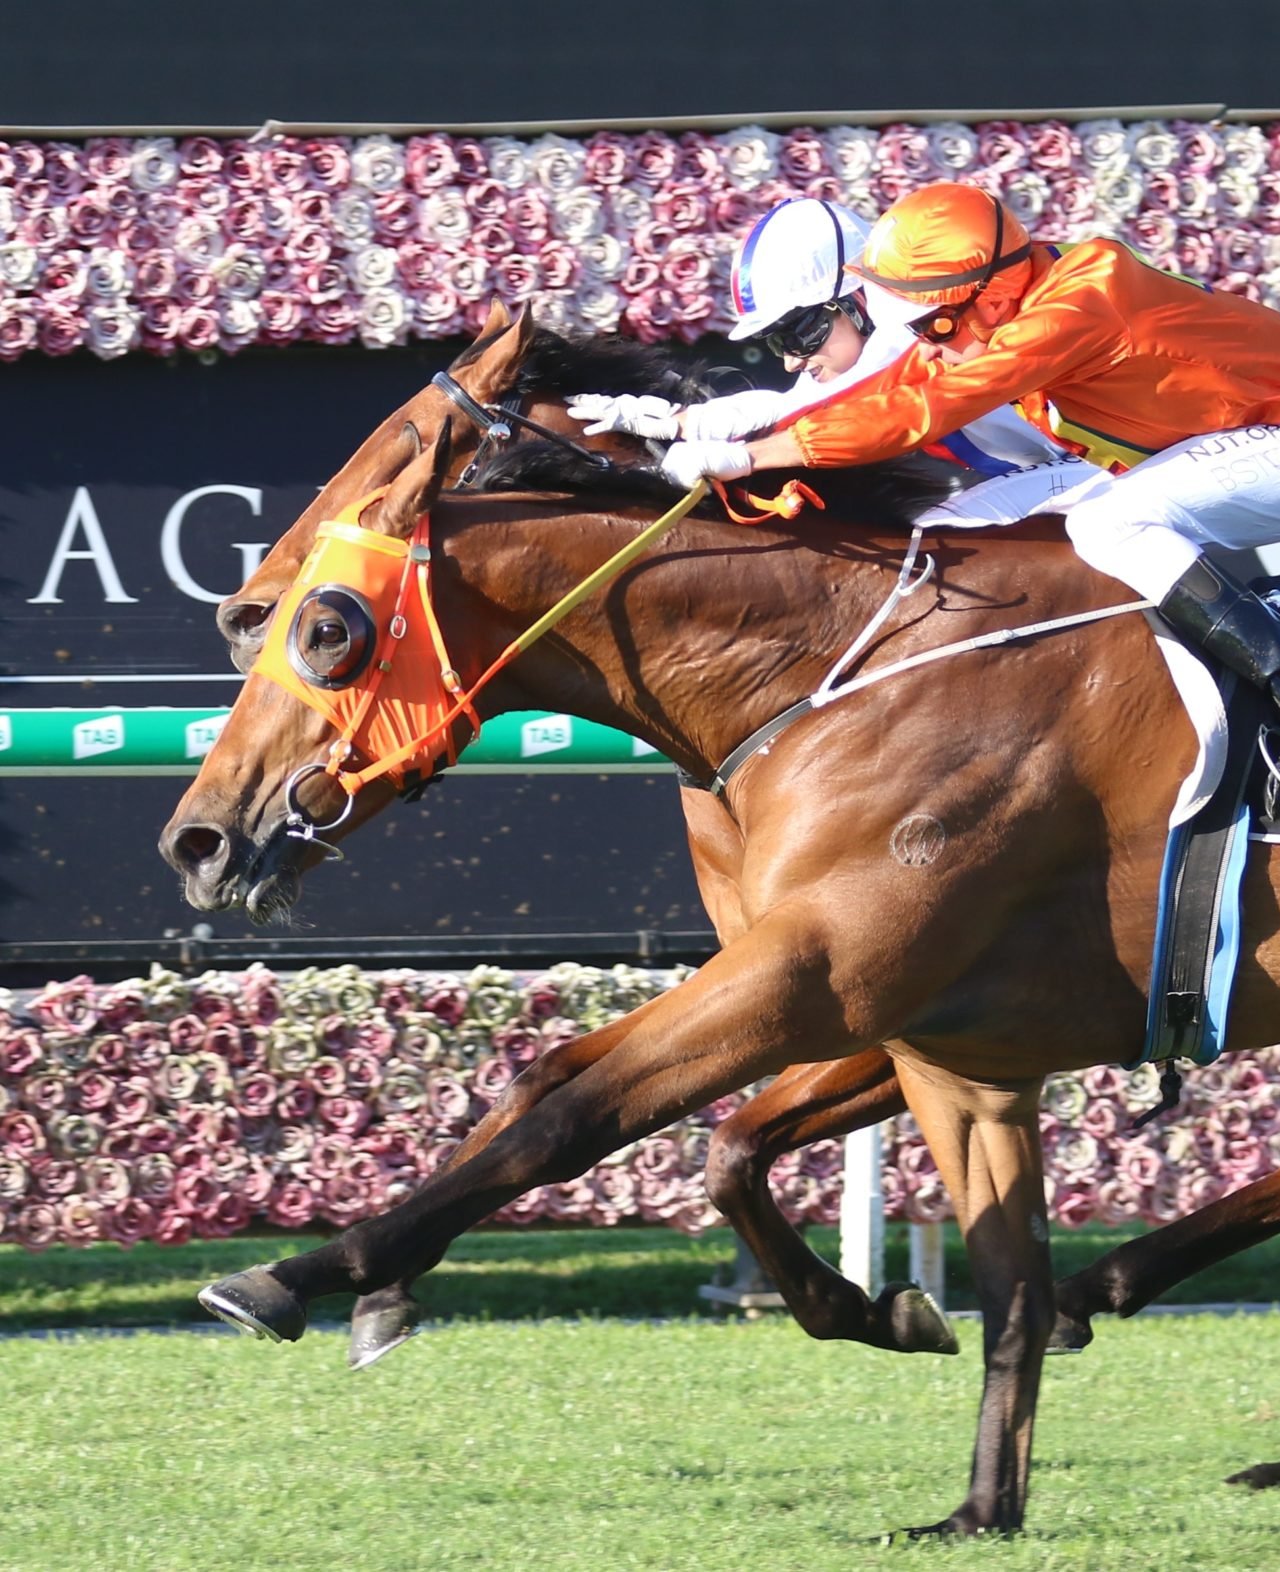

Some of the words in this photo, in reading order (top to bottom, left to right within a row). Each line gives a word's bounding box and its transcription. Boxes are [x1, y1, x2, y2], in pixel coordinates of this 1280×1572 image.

[26, 484, 326, 603] AG
[80, 729, 117, 745] TAB
[193, 728, 222, 744] TA
[529, 727, 566, 744] TAB
